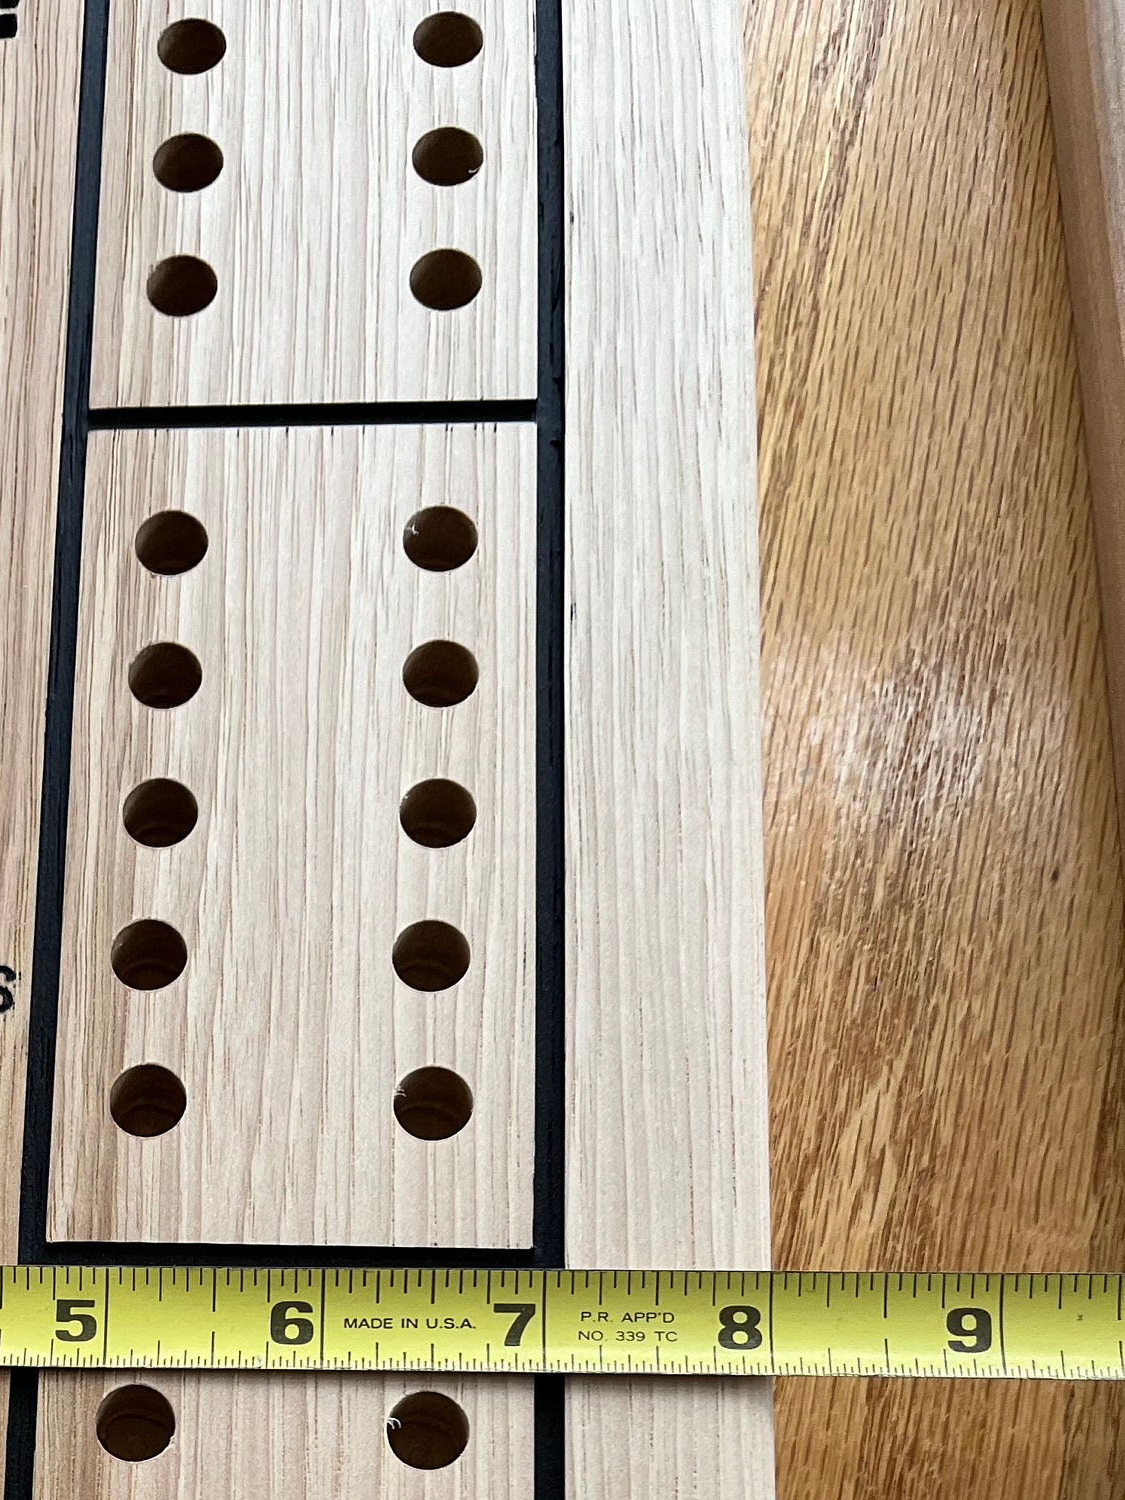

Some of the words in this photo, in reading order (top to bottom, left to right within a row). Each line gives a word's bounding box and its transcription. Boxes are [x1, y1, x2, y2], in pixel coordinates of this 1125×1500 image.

[55, 1299, 97, 1342] 5
[270, 1301, 315, 1346] 6
[343, 1317, 393, 1330] MADE
[401, 1318, 418, 1330] IN
[426, 1318, 477, 1330] U.S.A.
[492, 1303, 536, 1347] 7
[578, 1330, 608, 1342] NO.
[615, 1331, 646, 1342] 339
[654, 1331, 678, 1342] TC
[580, 1311, 614, 1323] P.R.
[621, 1312, 675, 1323] APP'D
[717, 1305, 763, 1350] 8
[946, 1307, 993, 1354] 9
